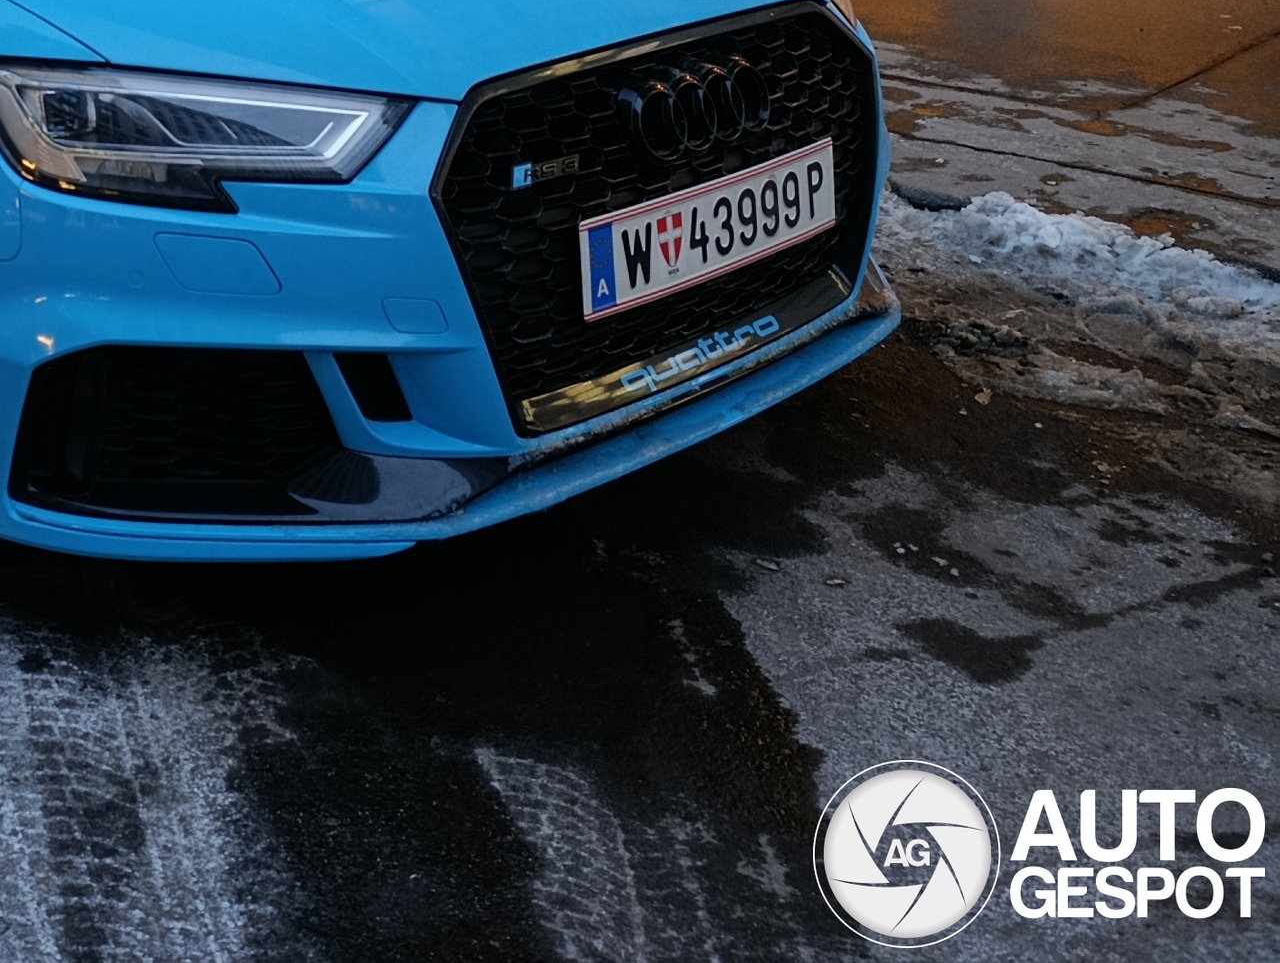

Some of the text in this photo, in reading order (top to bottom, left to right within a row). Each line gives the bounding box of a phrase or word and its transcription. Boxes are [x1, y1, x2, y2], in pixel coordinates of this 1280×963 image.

[597, 278, 609, 298] A
[621, 222, 652, 288] W
[621, 315, 780, 393] quattro
